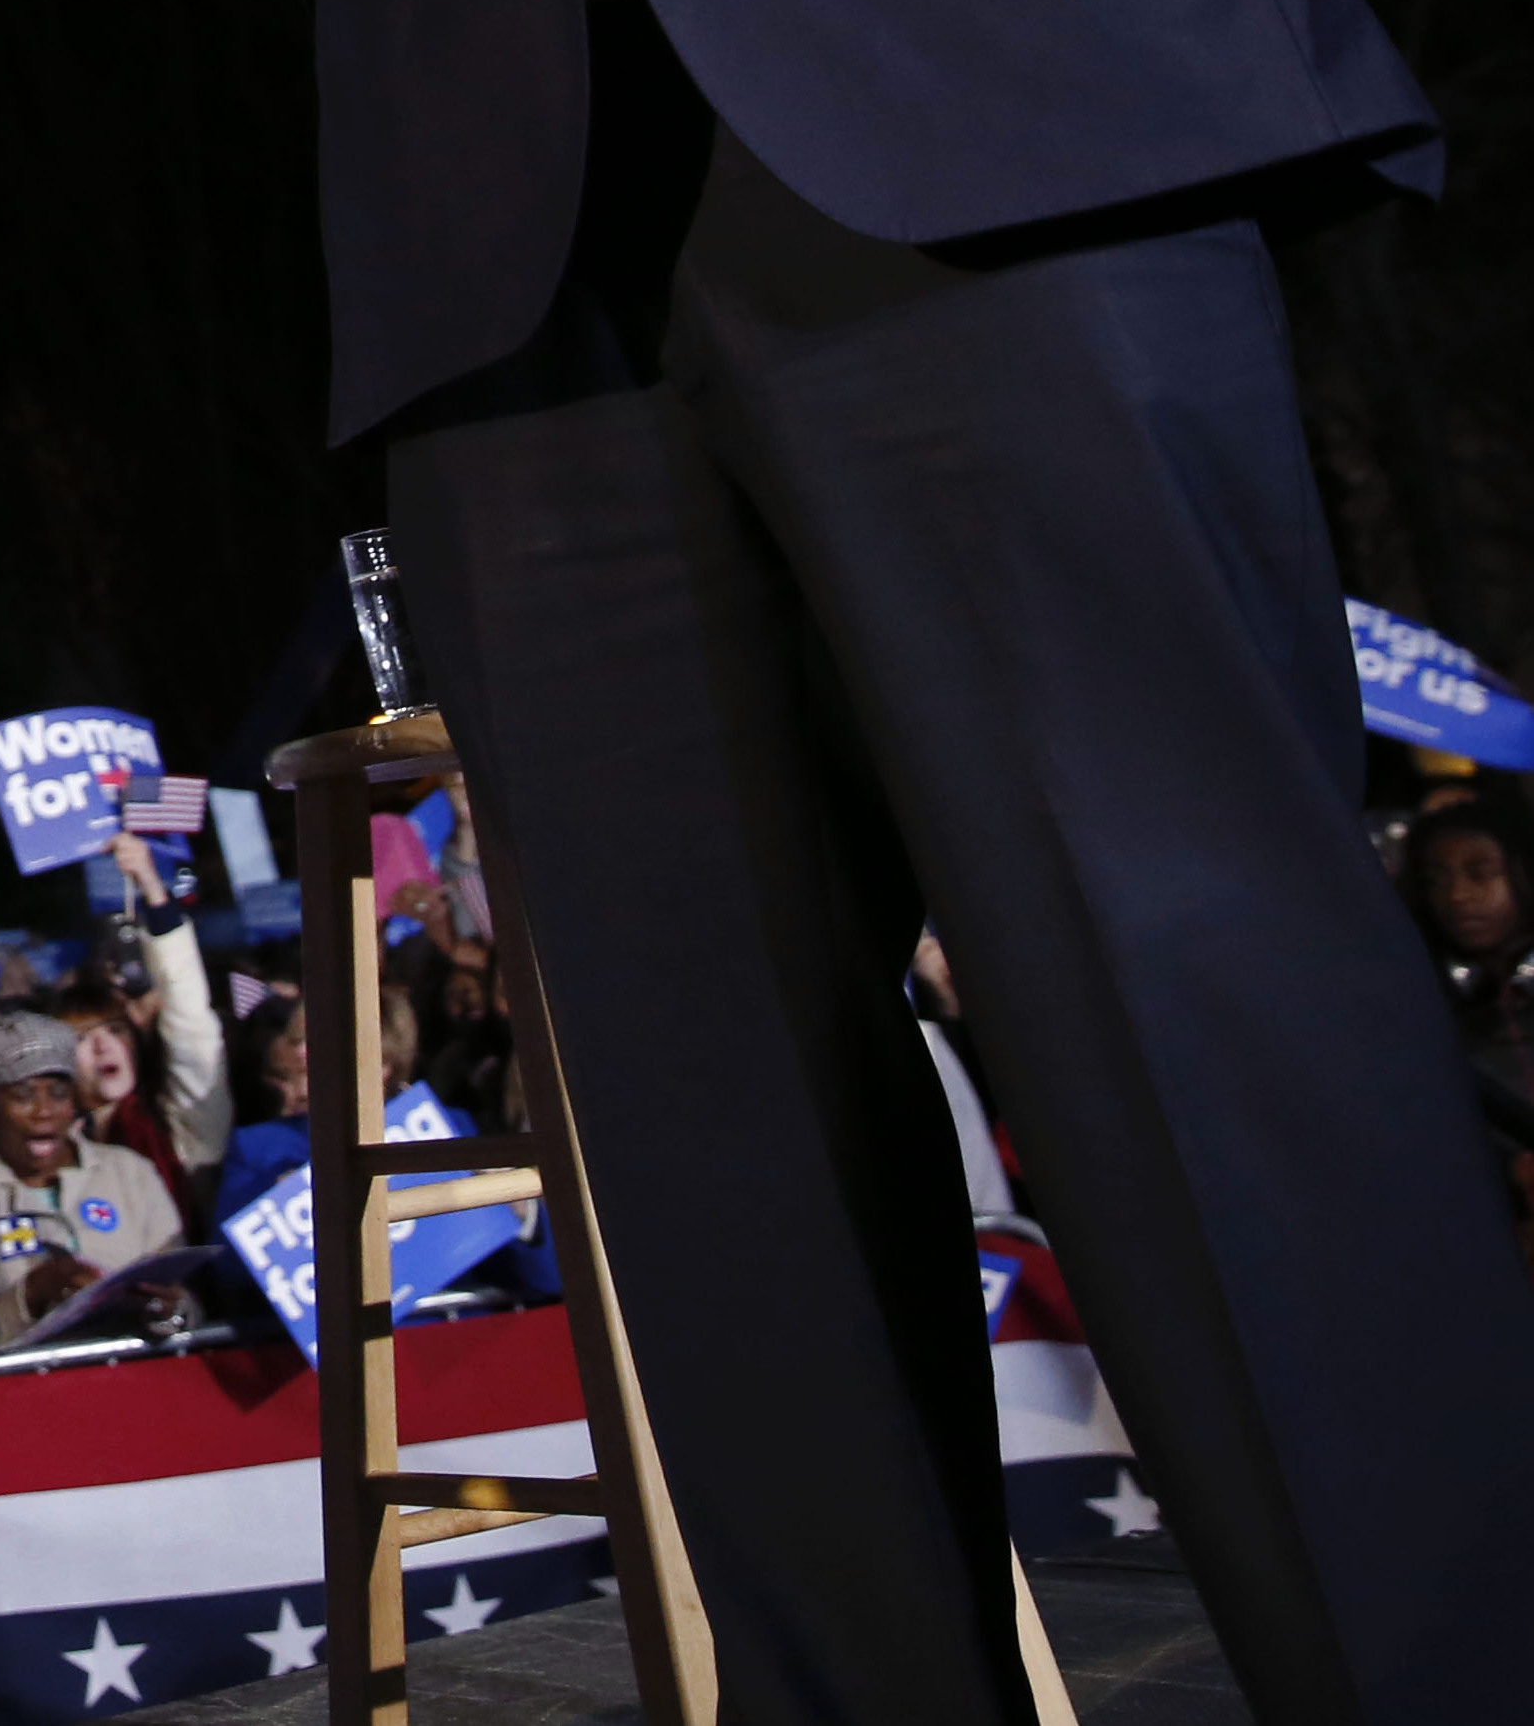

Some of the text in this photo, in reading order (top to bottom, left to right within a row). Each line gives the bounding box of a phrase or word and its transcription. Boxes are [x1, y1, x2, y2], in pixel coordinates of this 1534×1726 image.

[1354, 646, 1488, 715] or us
[5, 771, 91, 827] for
[264, 1262, 316, 1321] fo
